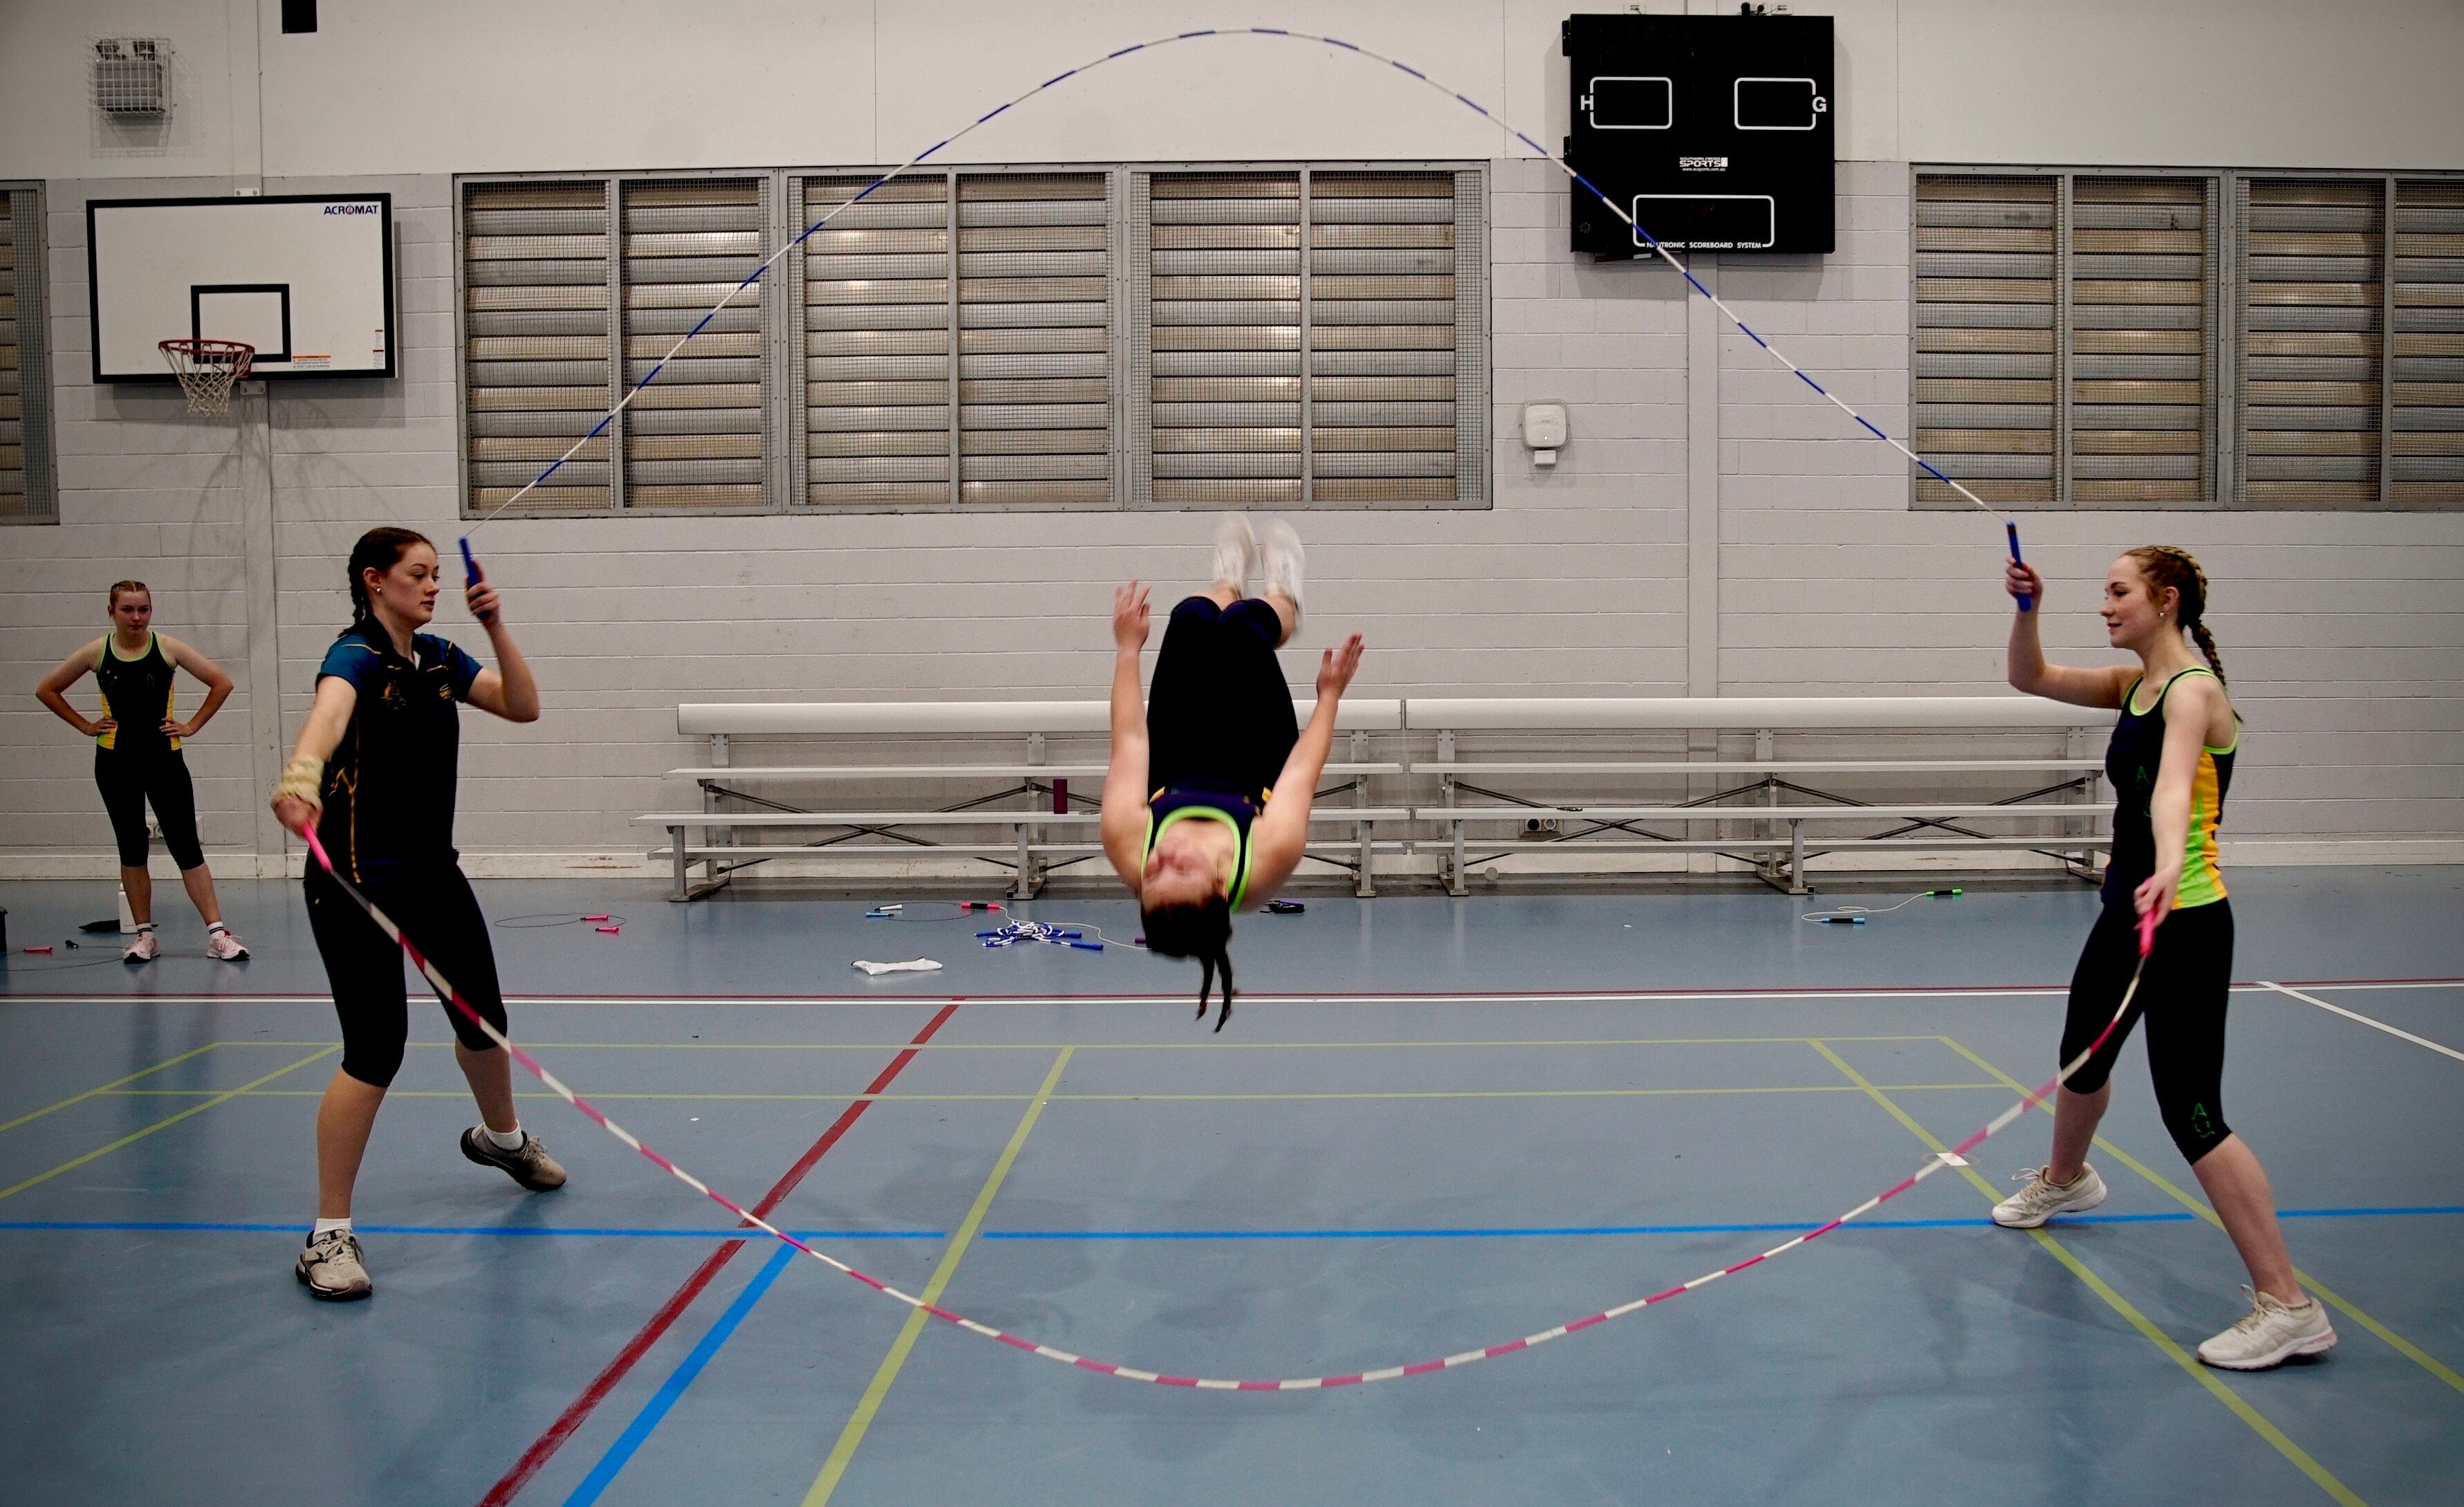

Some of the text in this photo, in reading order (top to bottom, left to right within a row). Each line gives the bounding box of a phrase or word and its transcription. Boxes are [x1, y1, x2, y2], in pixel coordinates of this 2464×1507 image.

[1580, 95, 1594, 111] H
[1812, 96, 1827, 113] G
[323, 205, 379, 216] ACROMAT
